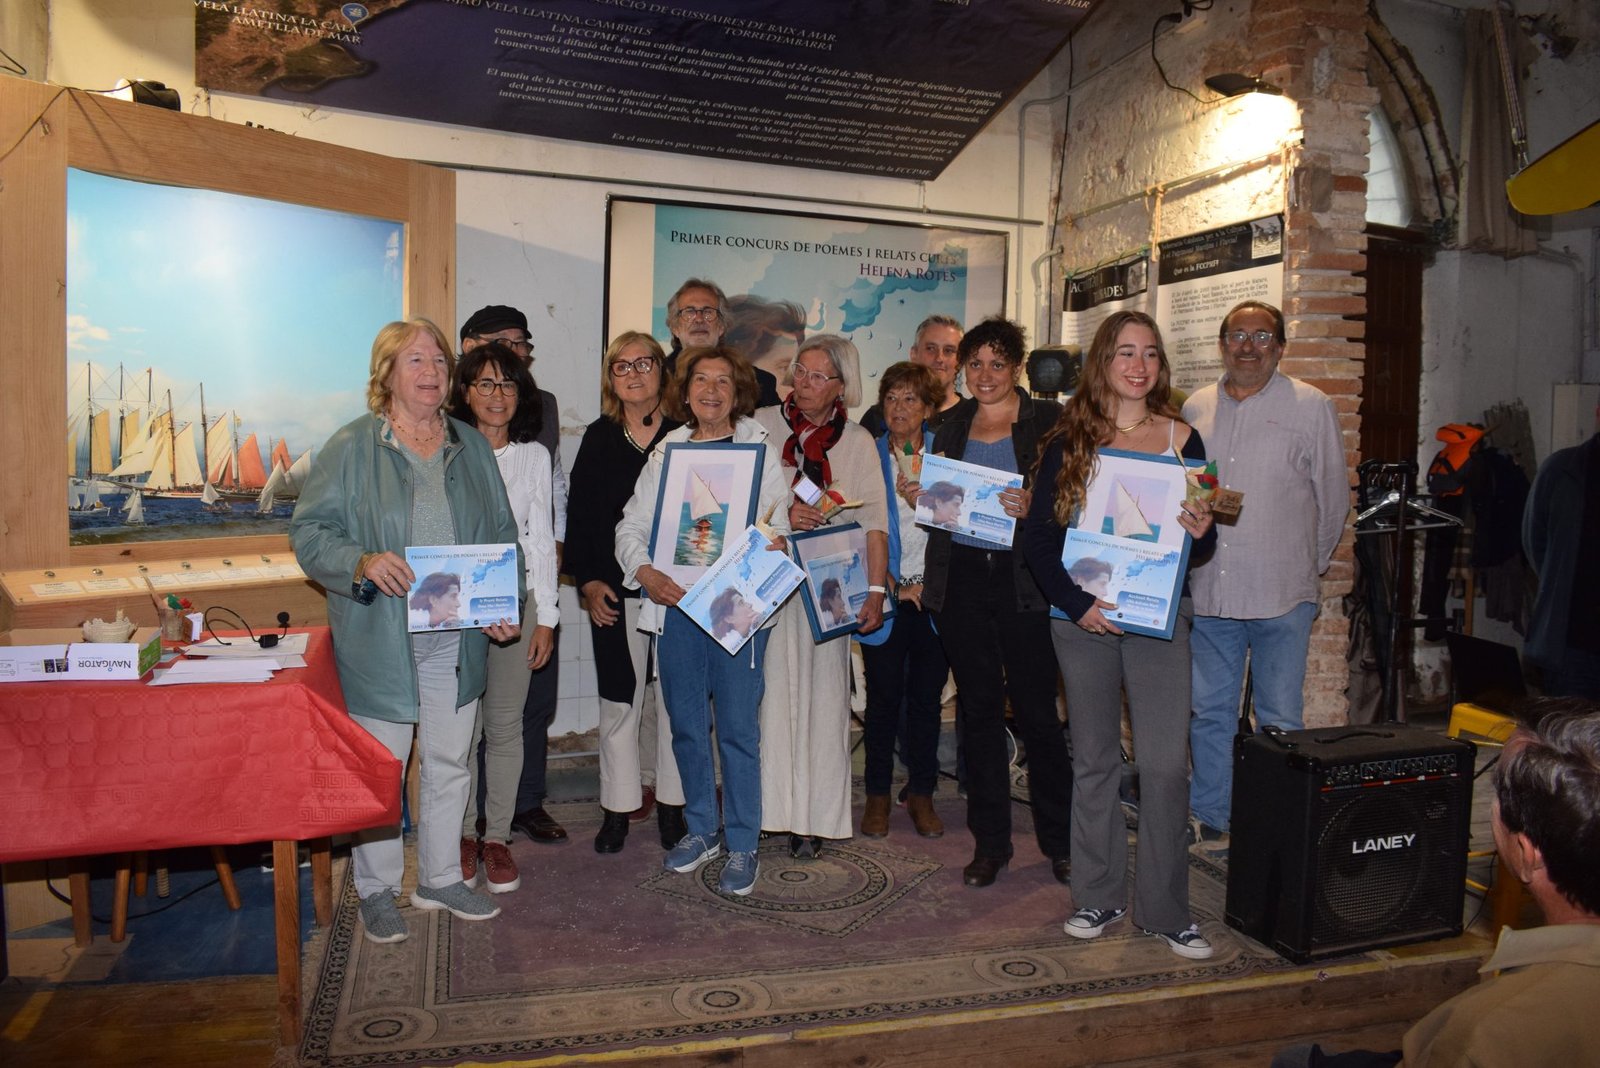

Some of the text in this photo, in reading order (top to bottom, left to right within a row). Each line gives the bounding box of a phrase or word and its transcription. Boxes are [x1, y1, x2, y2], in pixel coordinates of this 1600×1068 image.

[232, 14, 360, 43] AMETLLA DE MAR
[233, 5, 296, 23] LLATINA
[300, 17, 317, 26] LA
[485, 1, 518, 14] VELA
[584, 18, 651, 36] CAMBRILS
[551, 25, 565, 33] La
[568, 28, 616, 42] FCCPMF
[619, 36, 629, 44] és
[652, 43, 684, 52] entitat
[746, 57, 784, 68] fundada
[808, 66, 838, 76] d'abril
[839, 70, 850, 78] de
[725, 27, 832, 50] TORREDEMBARRA
[494, 28, 555, 42] conservació
[563, 37, 598, 49] difusió
[599, 43, 611, 51] de
[625, 49, 660, 59] cultura
[678, 58, 726, 69] patrimoni
[771, 70, 800, 80] fluvial
[670, 230, 722, 246] PRIMER
[726, 236, 790, 252] CONCURS
[794, 242, 811, 254] DE
[814, 244, 863, 258] POEMES
[866, 247, 871, 258] I
[875, 248, 917, 262] RELATS
[860, 263, 911, 279] HELENA
[1352, 833, 1415, 854] LANEY
